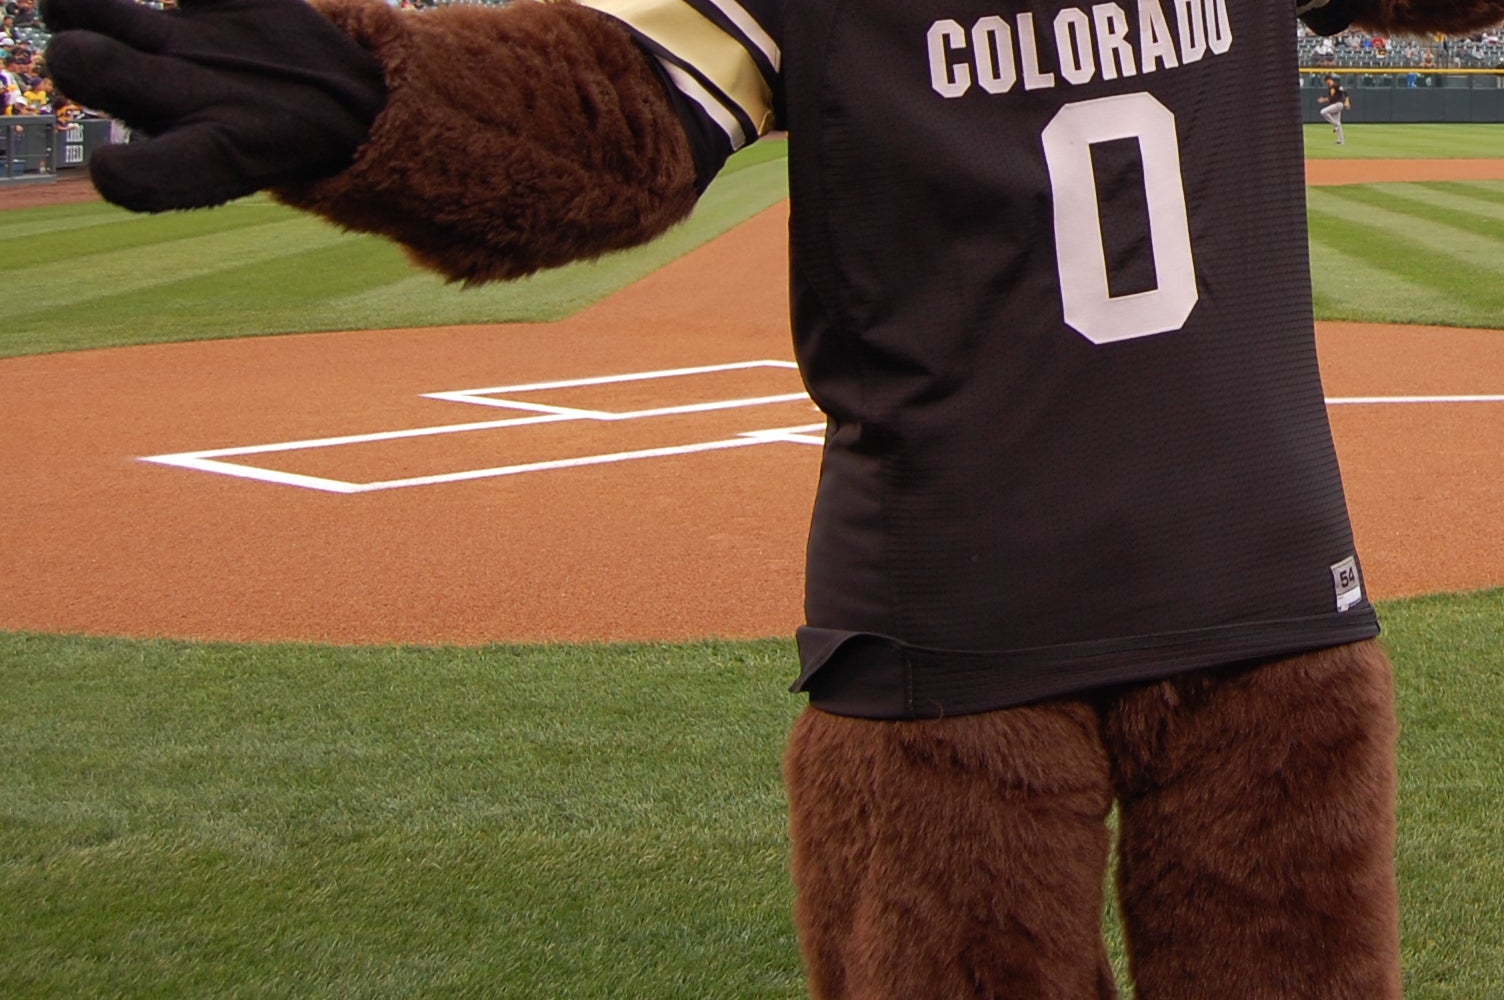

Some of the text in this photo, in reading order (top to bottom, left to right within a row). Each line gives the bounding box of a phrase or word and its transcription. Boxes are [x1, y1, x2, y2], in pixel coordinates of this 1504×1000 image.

[66, 145, 83, 163] FIELD
[1041, 92, 1199, 345] 0
[1339, 567, 1355, 588] 54
